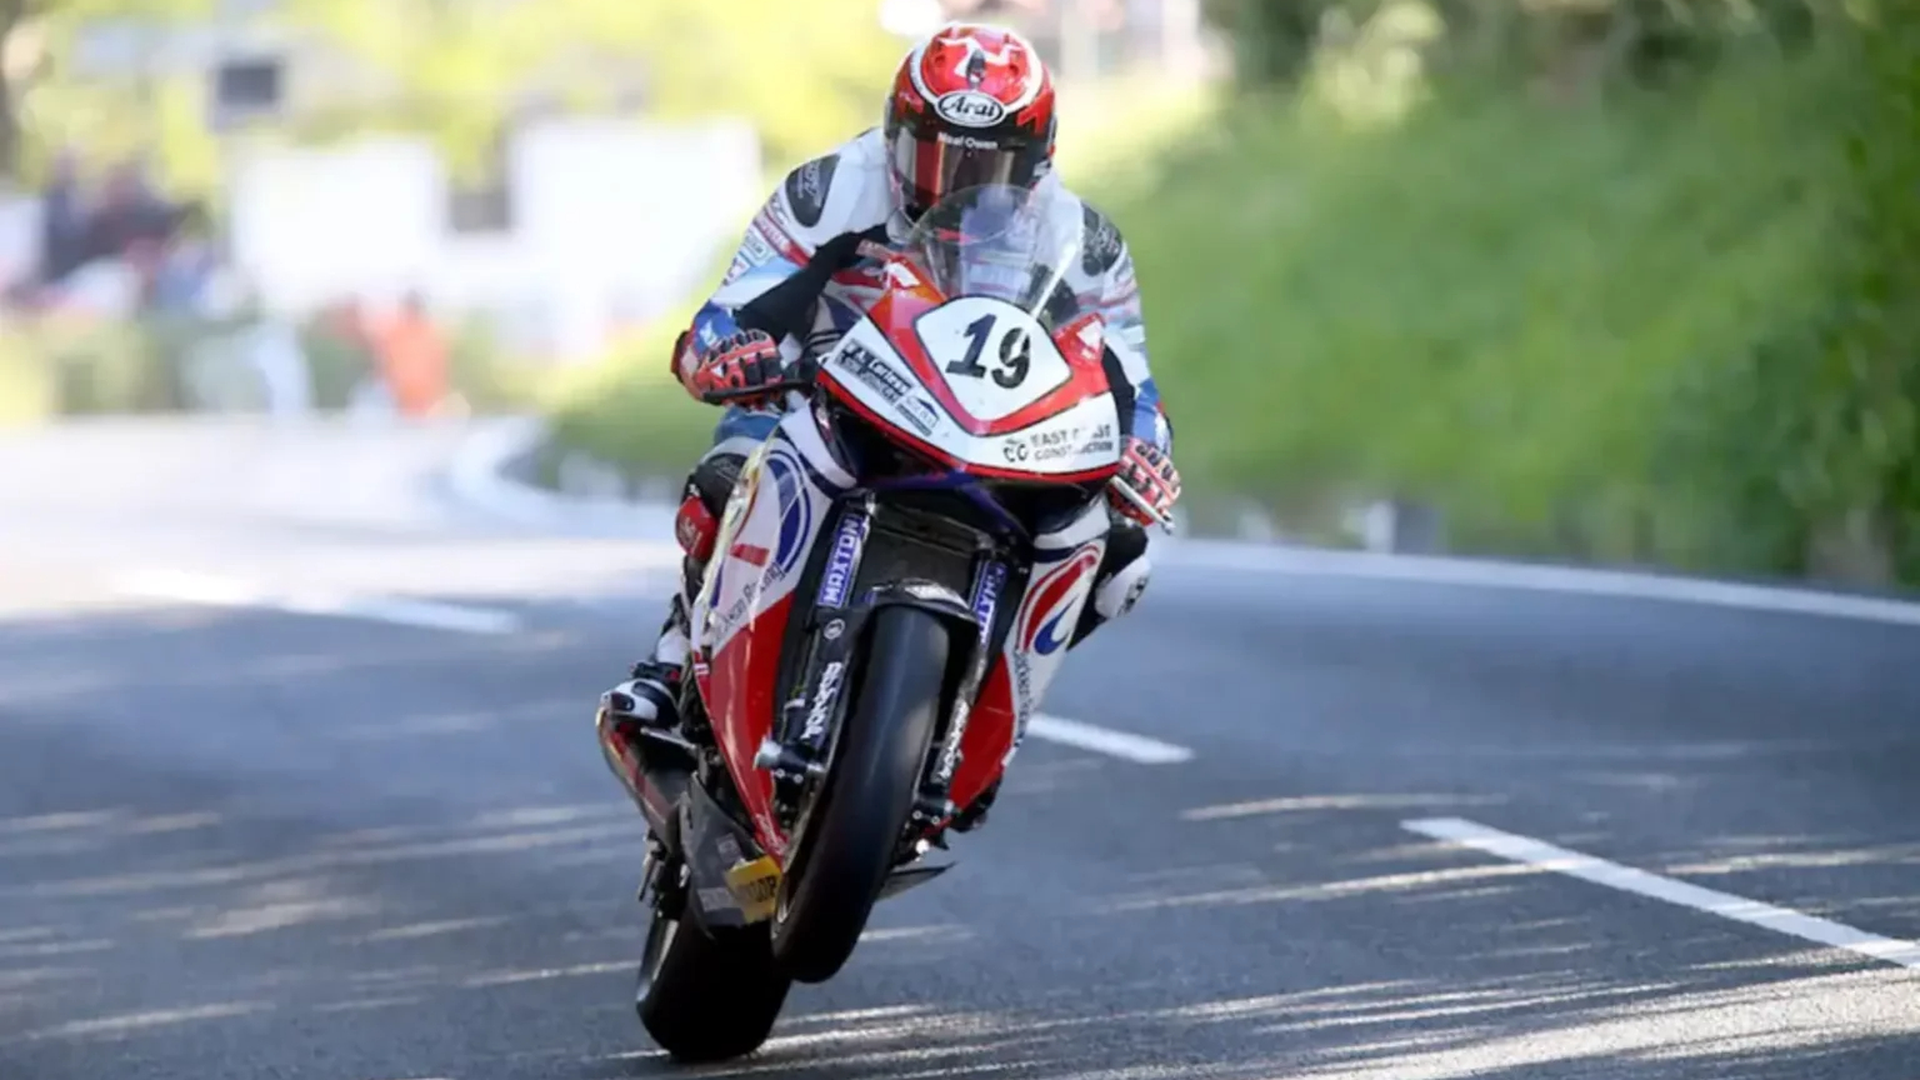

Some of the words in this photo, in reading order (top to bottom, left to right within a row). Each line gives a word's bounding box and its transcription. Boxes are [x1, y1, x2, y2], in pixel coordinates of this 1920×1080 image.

[942, 95, 995, 117] Arai
[965, 137, 998, 150] Owen
[945, 313, 1030, 389] 19
[1030, 429, 1067, 447] EAST
[823, 517, 860, 603] MAXTON
